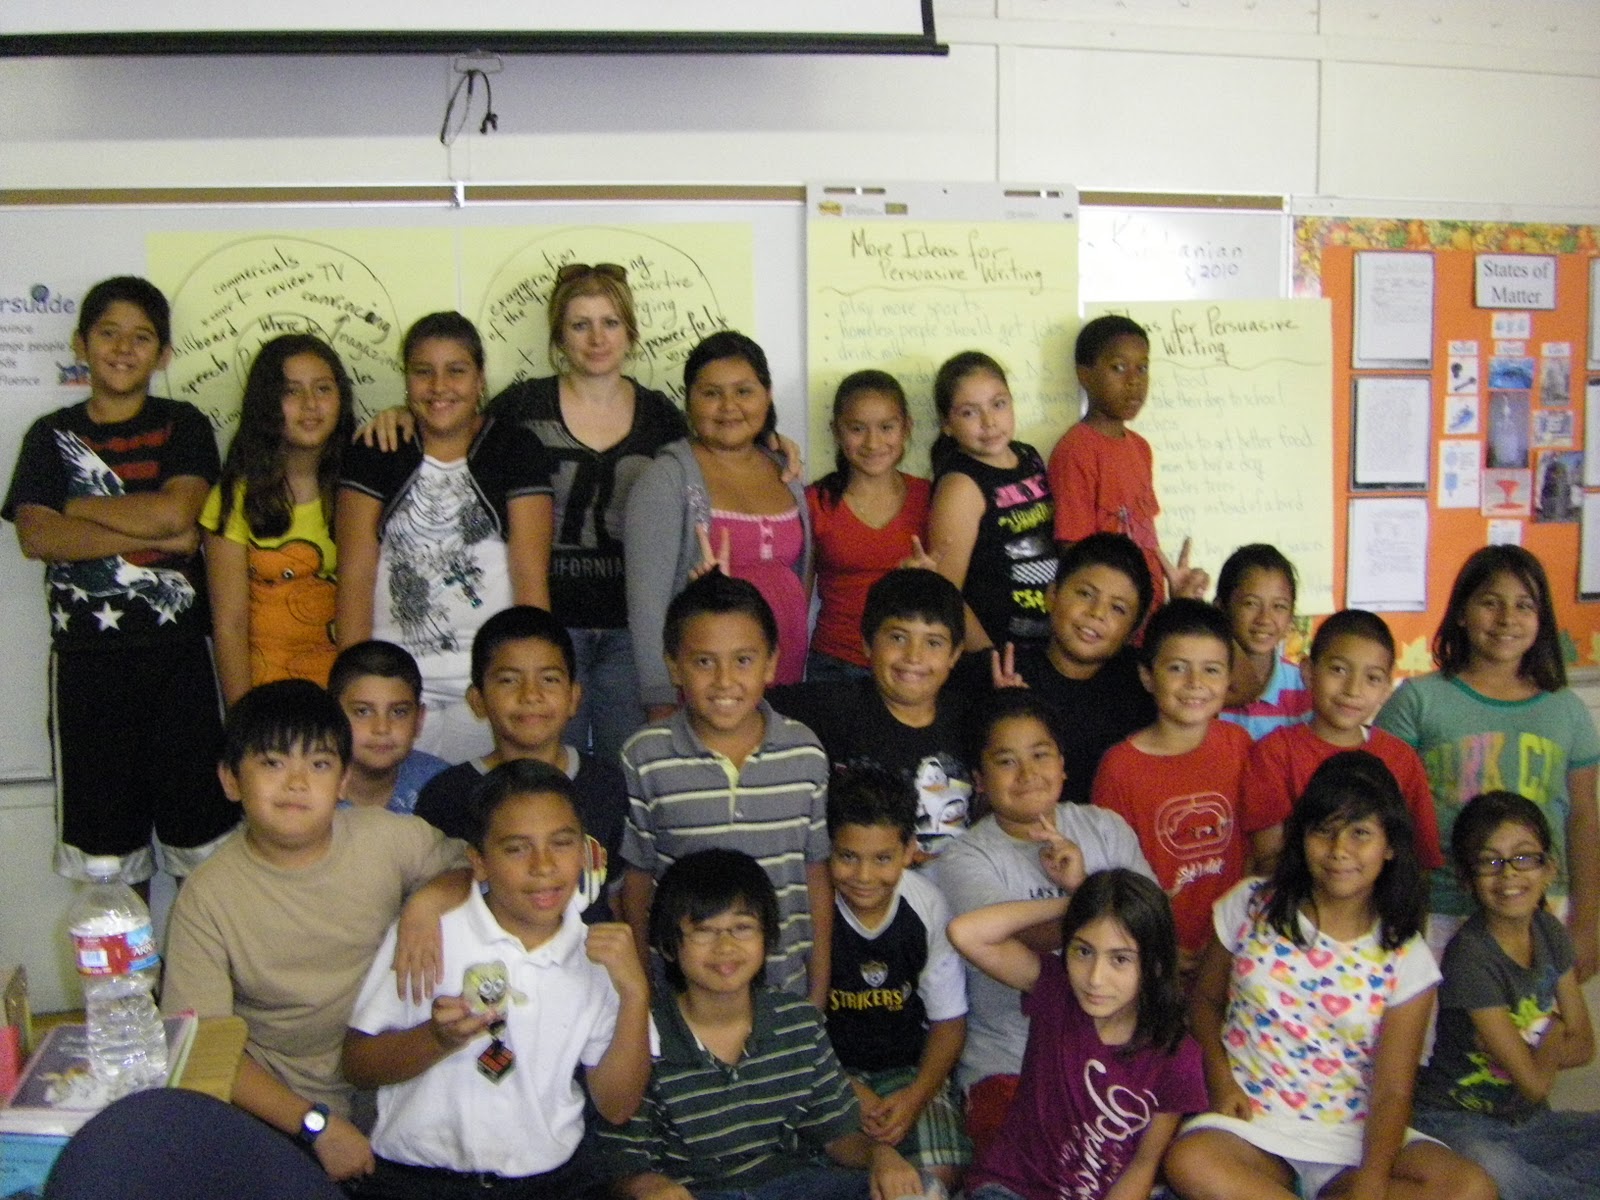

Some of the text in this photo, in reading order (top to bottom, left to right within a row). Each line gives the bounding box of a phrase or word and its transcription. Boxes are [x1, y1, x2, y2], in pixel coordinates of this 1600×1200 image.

[851, 227, 1008, 269] More Ideas for
[265, 262, 345, 298] reviews TV
[879, 256, 1043, 295] Persuasive Writing
[1484, 260, 1551, 279] States of
[0, 292, 76, 314] rsuade
[1491, 286, 1543, 306] Matter
[503, 309, 527, 327] the
[1172, 307, 1198, 345] for
[1206, 306, 1300, 337] Persuasive
[1162, 337, 1230, 366] Writing
[181, 352, 229, 395] speech
[1279, 424, 1316, 448] food
[830, 989, 904, 1011] STRIKERS
